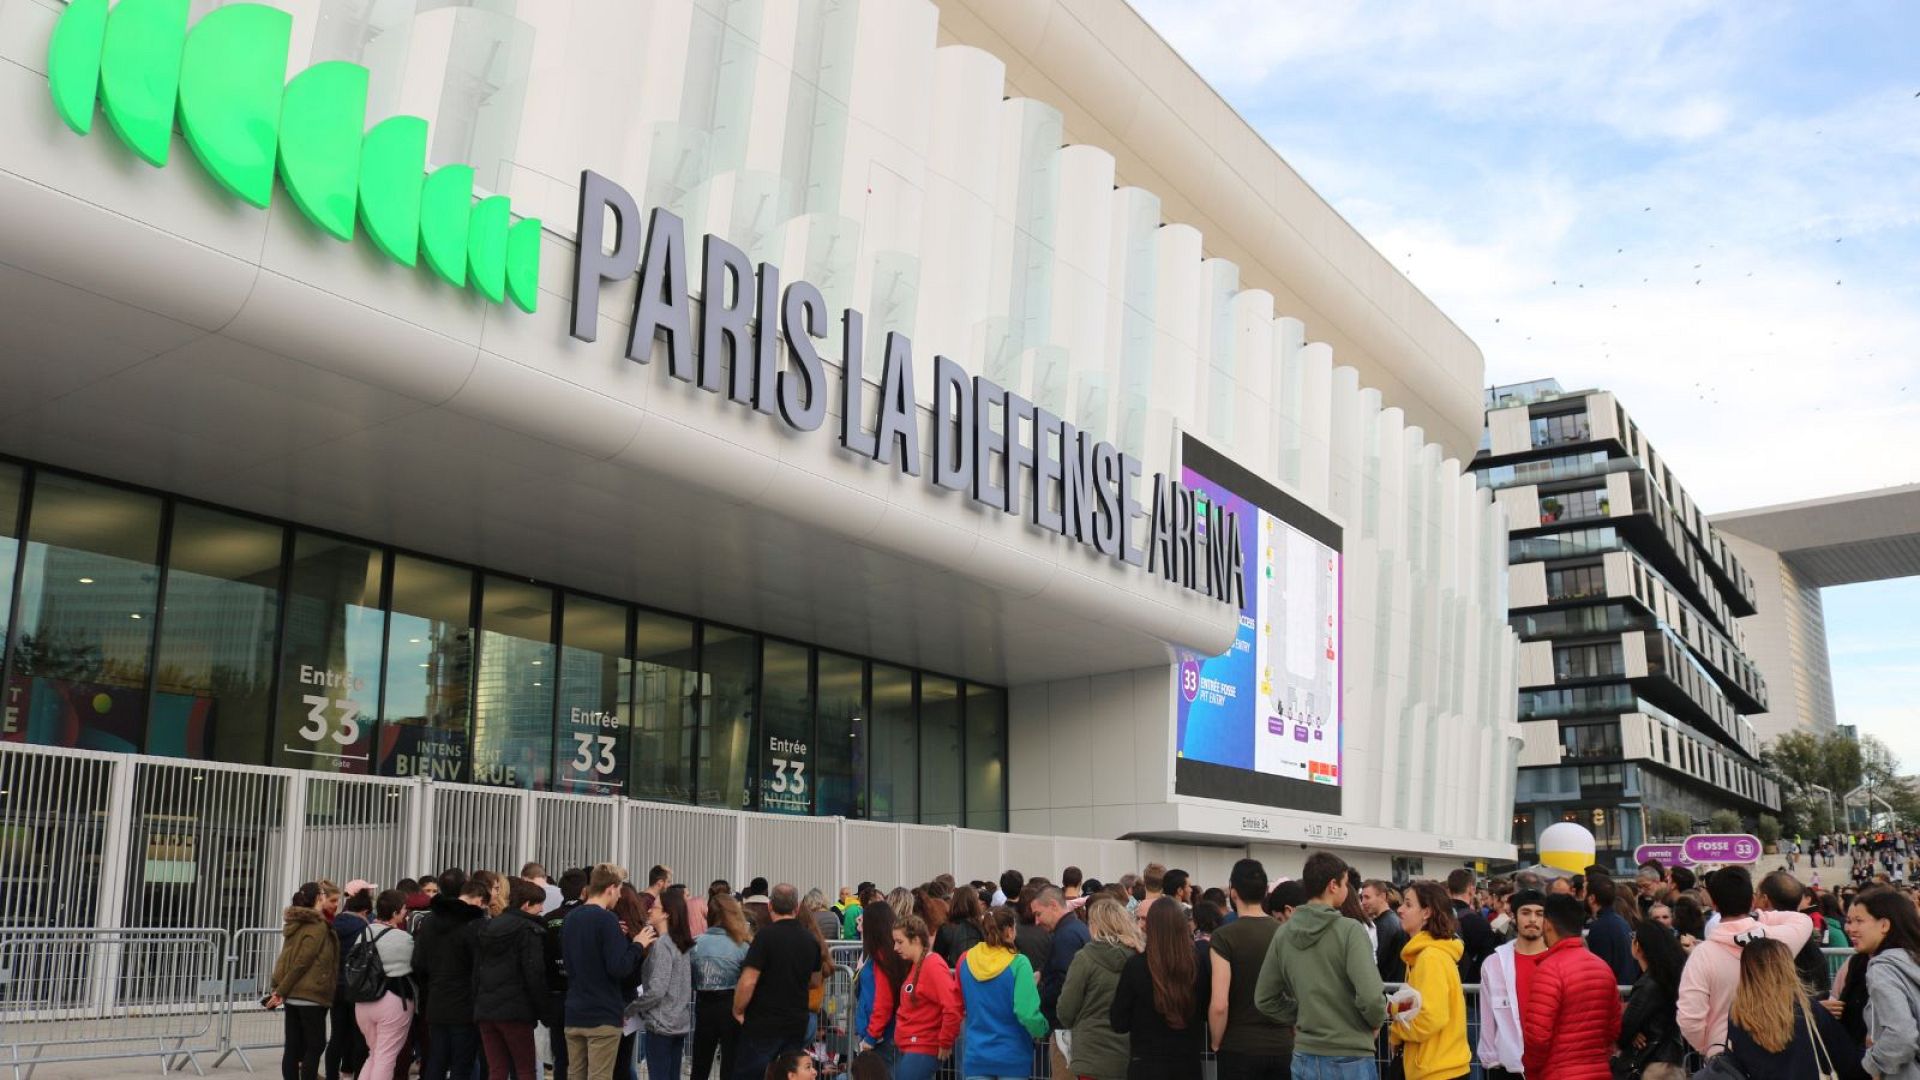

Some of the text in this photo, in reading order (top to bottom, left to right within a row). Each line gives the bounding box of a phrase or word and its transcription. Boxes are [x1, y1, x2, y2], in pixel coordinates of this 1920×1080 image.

[570, 169, 1247, 609] PARIS LA DEFENSE ARENA
[299, 664, 364, 692] Entrée
[1184, 669, 1196, 692] 33
[298, 694, 360, 745] 33
[571, 707, 619, 729] Entrée
[572, 732, 616, 775] 33
[769, 736, 807, 755] Entrée
[771, 758, 805, 795] 33
[1648, 850, 1672, 858] ENTRÉE
[1697, 842, 1752, 854] FOSSE 33
